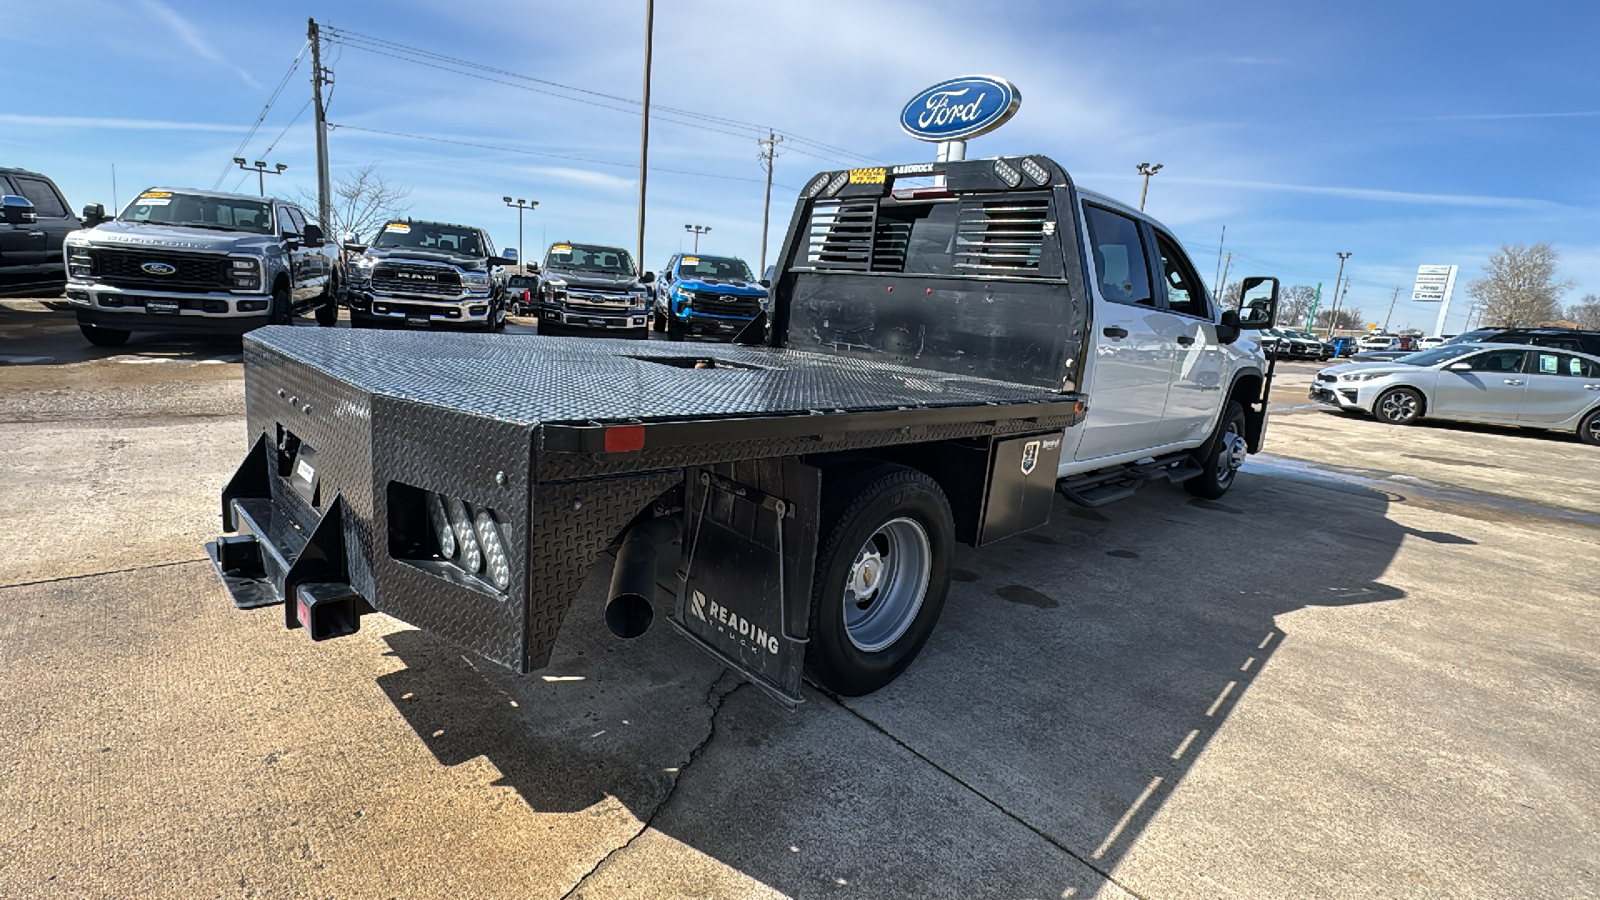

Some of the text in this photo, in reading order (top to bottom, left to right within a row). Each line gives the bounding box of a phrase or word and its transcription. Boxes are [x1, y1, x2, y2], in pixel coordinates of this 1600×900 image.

[918, 87, 986, 129] Ford
[398, 272, 436, 281] RAM
[709, 599, 779, 655] READING
[709, 619, 758, 654] TRUCK
